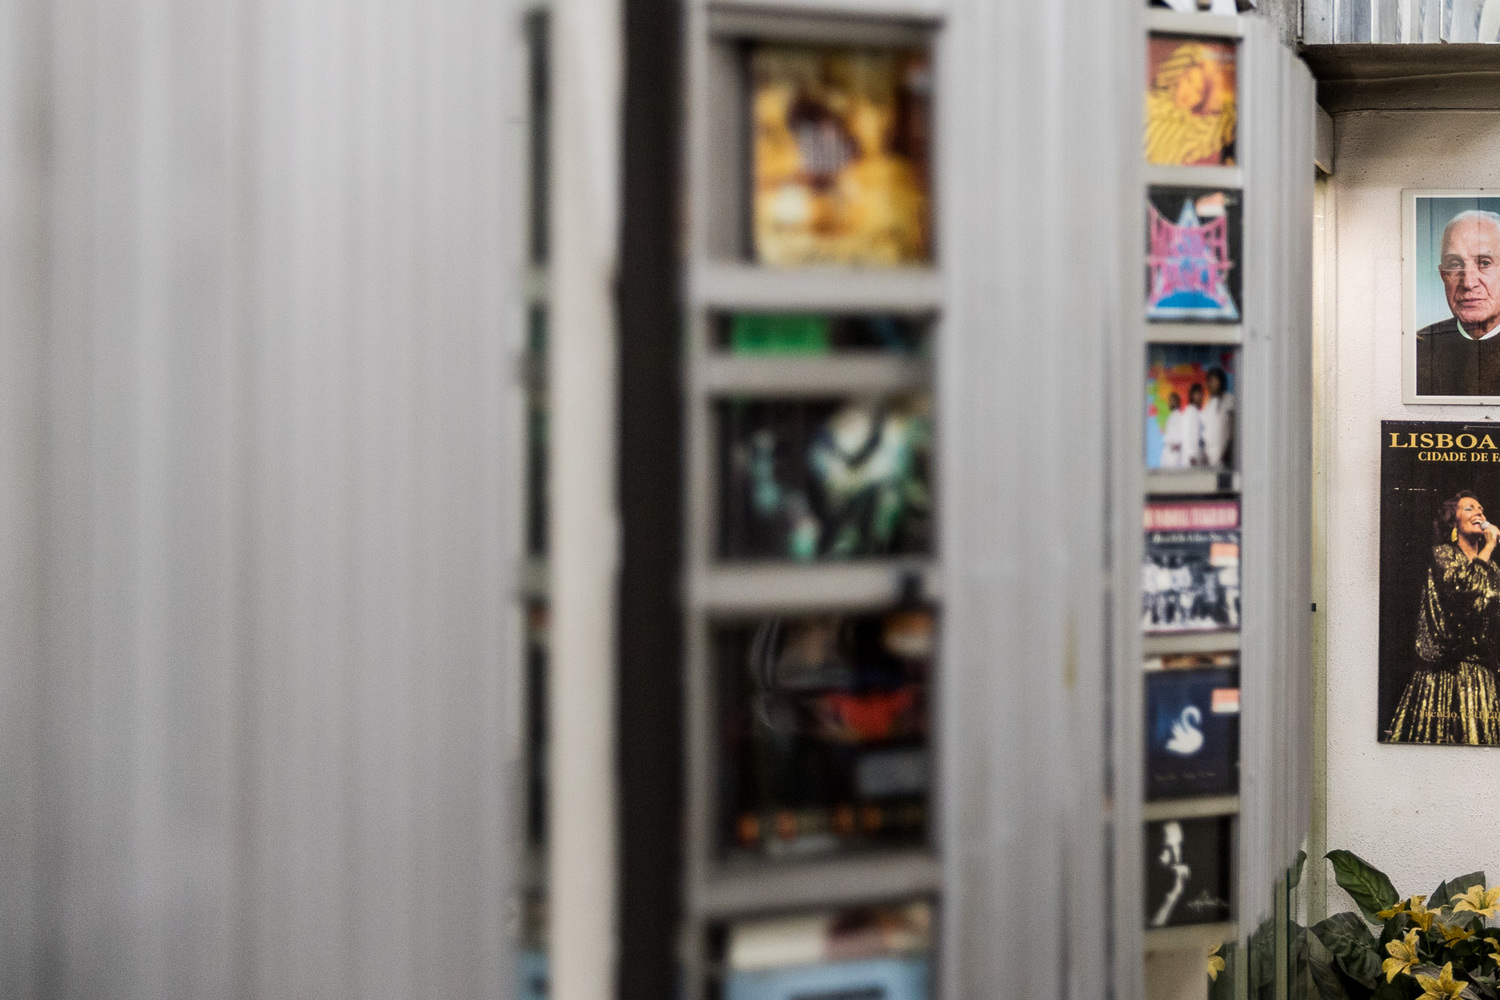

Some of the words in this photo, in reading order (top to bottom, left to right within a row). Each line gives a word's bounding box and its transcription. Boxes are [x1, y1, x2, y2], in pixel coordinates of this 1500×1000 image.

[1389, 432, 1498, 450] LISBOA
[1418, 451, 1467, 462] CIDADE
[1470, 452, 1489, 463] DE
